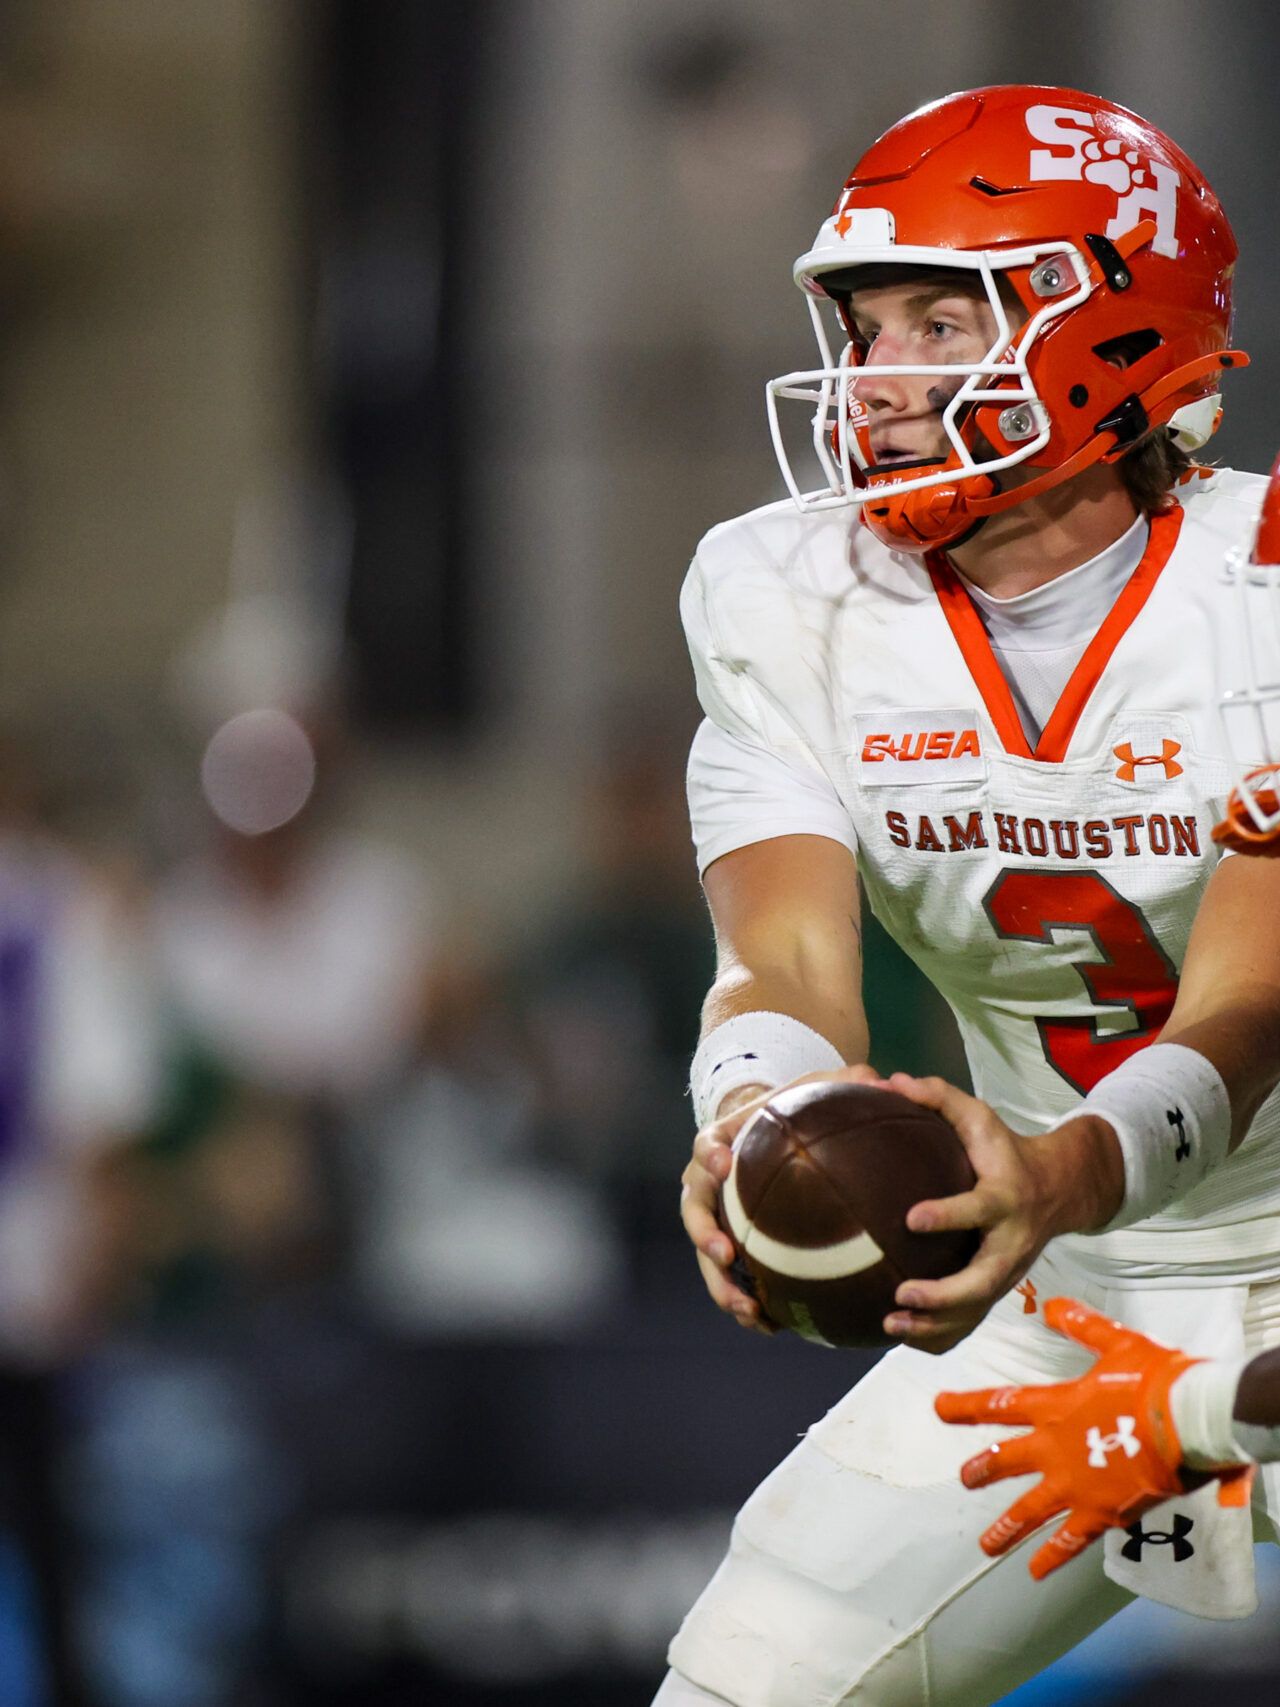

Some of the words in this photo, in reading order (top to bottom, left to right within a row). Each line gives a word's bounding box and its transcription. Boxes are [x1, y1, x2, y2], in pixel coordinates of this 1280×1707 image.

[885, 810, 989, 853] SAM
[993, 812, 1201, 860] HOUSTON
[981, 866, 1180, 1099] 3
